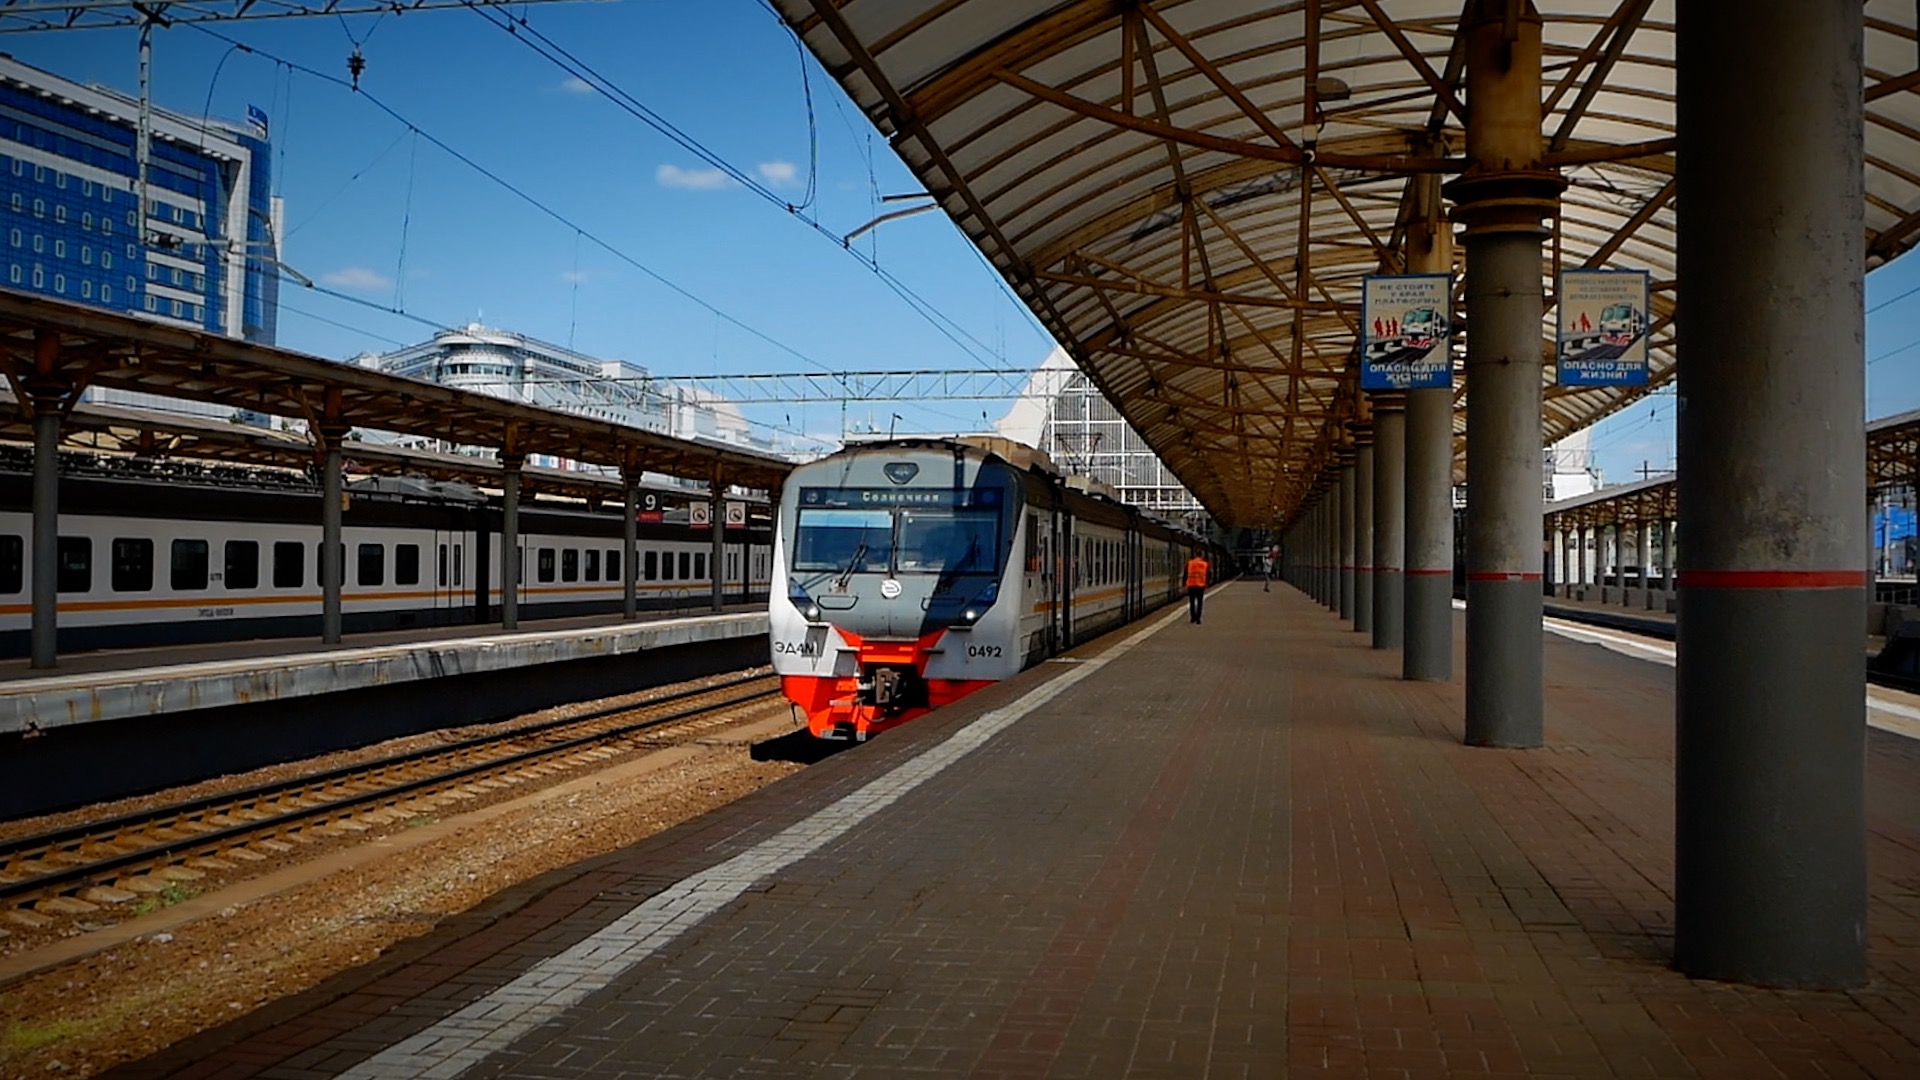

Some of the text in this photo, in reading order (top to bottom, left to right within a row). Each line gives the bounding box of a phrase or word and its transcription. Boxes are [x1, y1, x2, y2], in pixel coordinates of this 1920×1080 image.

[1369, 363, 1447, 373] ОПАСНО ДЛЯ
[1563, 361, 1643, 371] ОПАСНО ДЛЯ
[1580, 370, 1628, 380] ЖИЗНИ!
[862, 491, 939, 502] Солнечная
[645, 494, 657, 511] 9
[968, 645, 1002, 657] 0492
